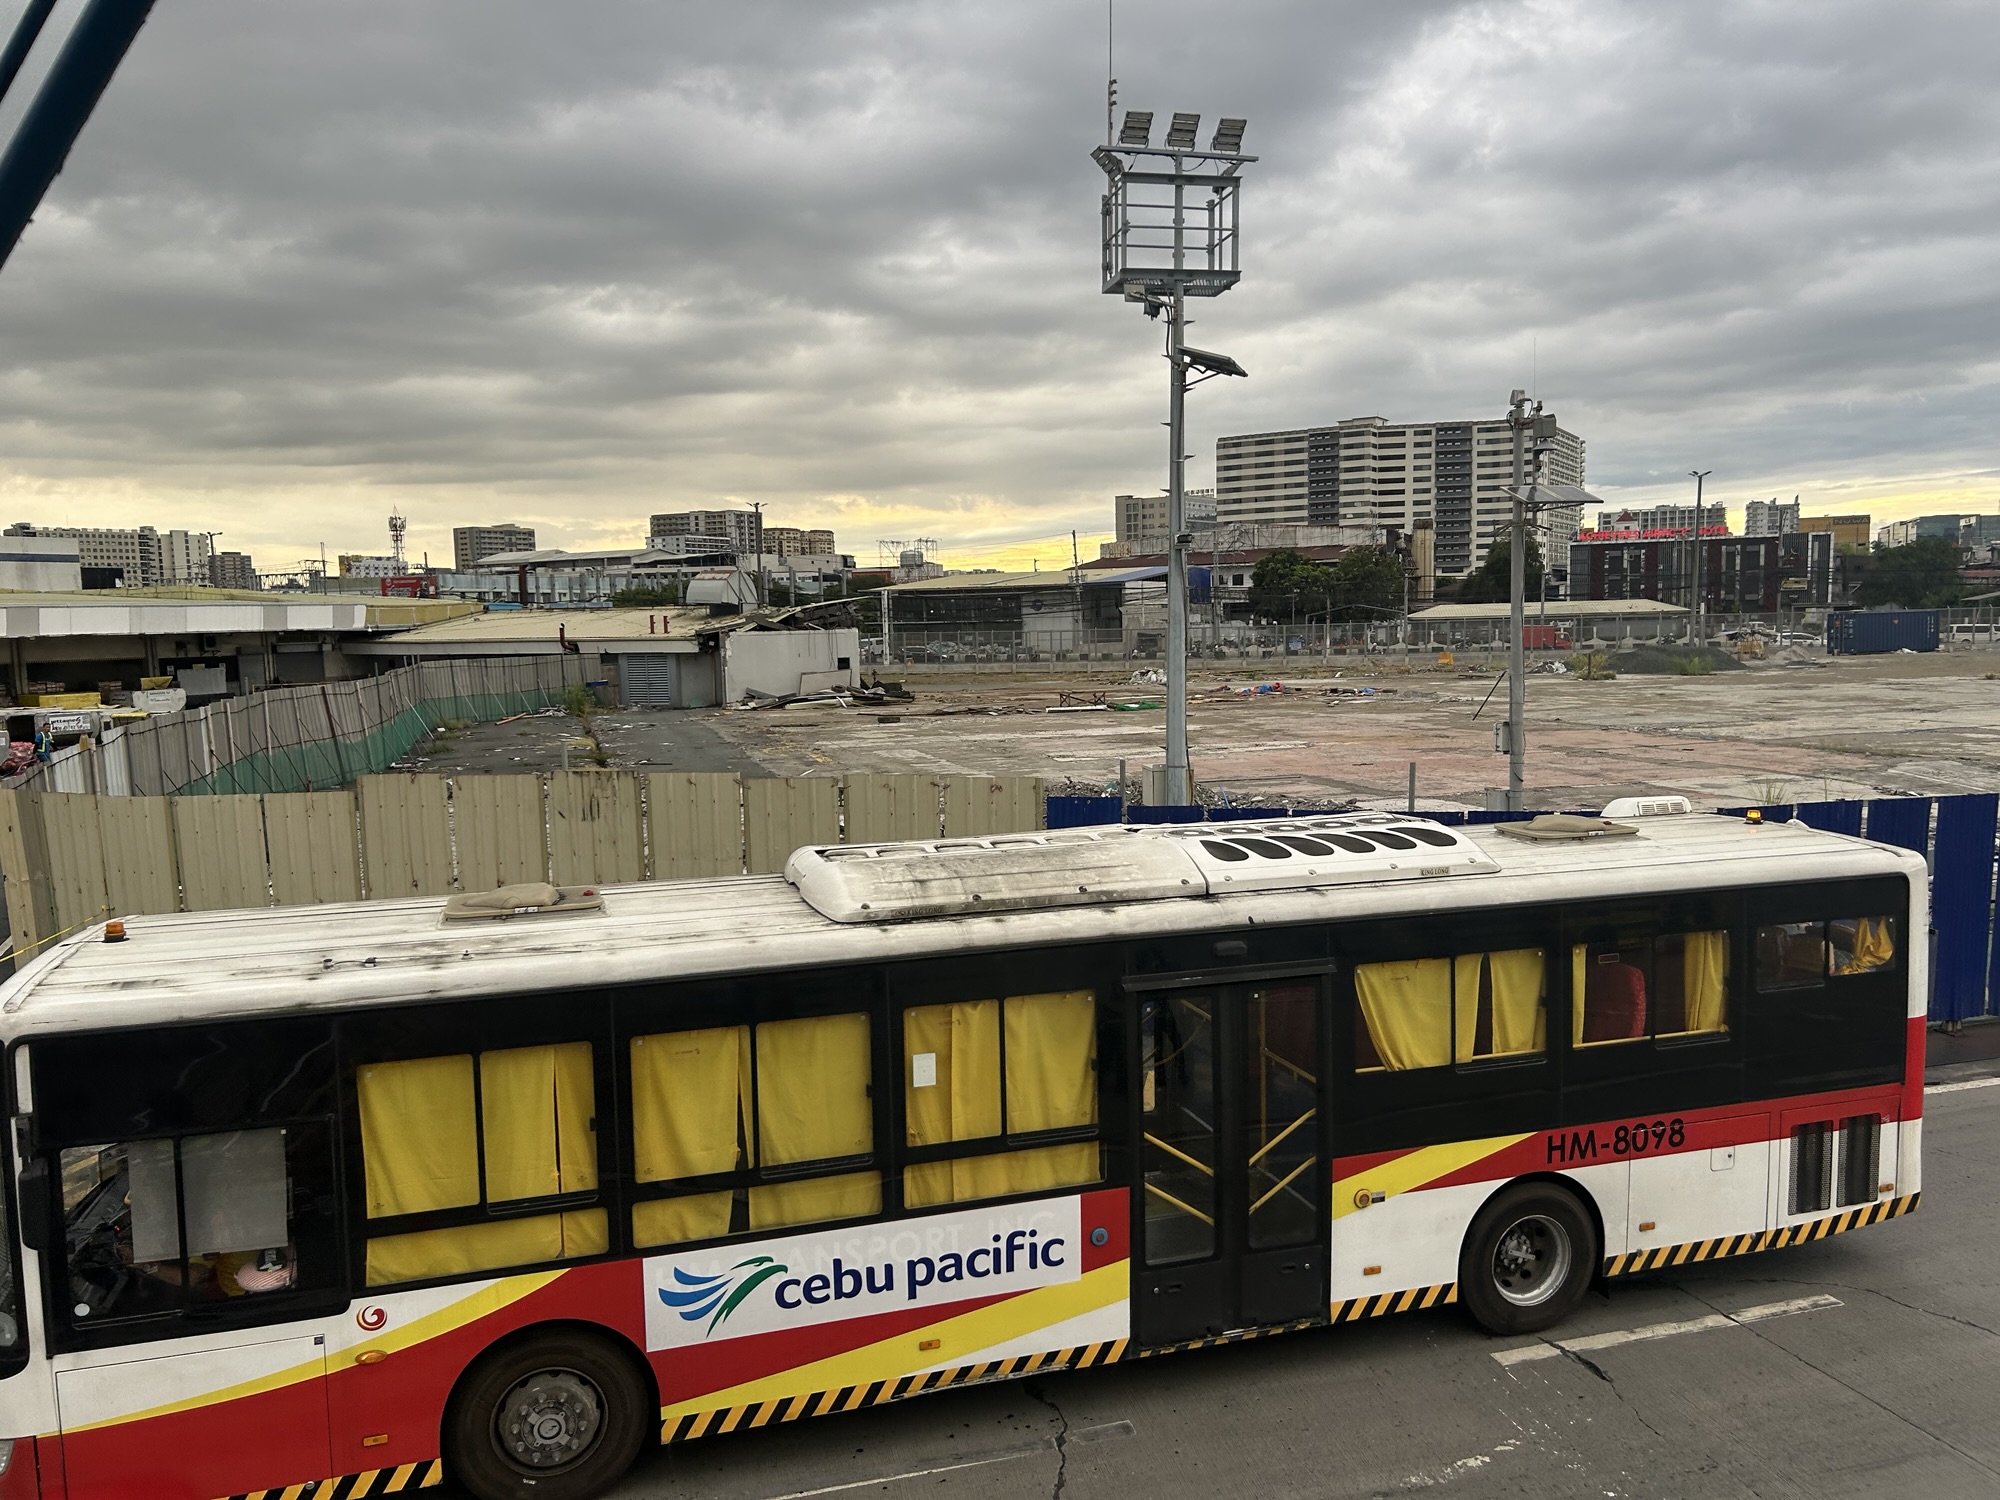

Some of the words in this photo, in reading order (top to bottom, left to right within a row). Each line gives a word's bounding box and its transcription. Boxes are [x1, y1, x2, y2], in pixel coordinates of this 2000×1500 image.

[1834, 517, 1869, 525] NUWA
[1421, 868, 1434, 876] KING
[1434, 867, 1449, 875] LONG
[1546, 1117, 1686, 1165] HM-8098
[774, 1258, 894, 1310] cebu
[907, 1228, 1065, 1300] pacific
